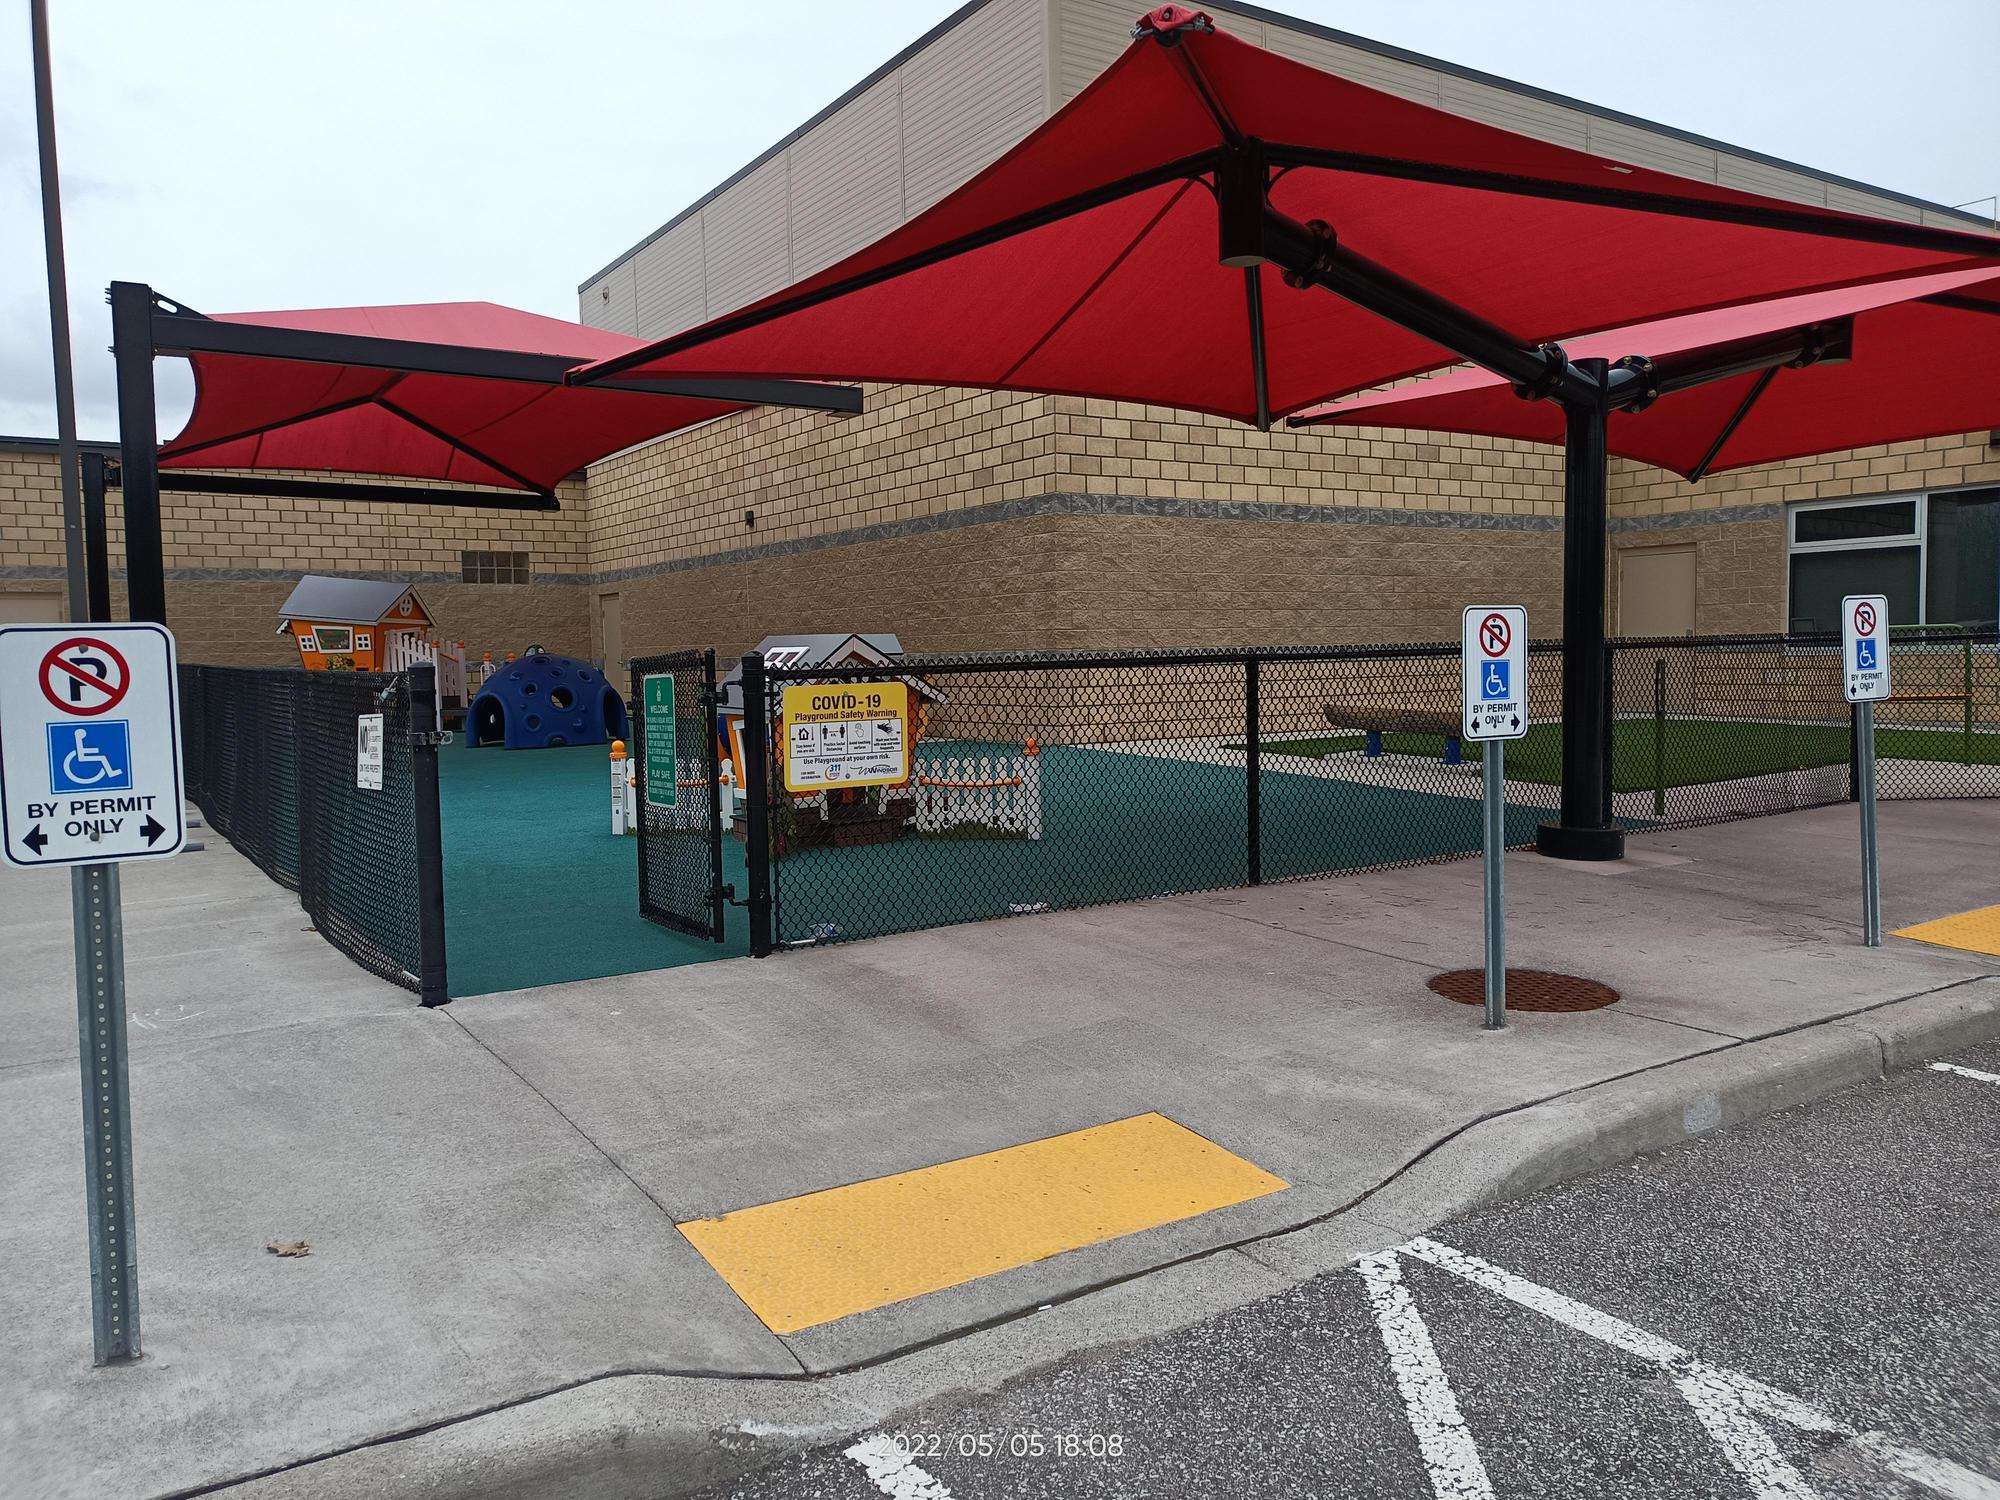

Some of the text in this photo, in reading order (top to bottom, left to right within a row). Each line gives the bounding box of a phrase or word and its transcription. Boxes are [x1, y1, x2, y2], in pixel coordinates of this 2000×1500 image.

[1861, 672, 1883, 681] PERMIT
[1860, 682, 1874, 690] ONLY
[812, 694, 881, 711] COVID-19
[1473, 702, 1518, 713] BY PERMIT
[650, 705, 669, 713] WELCOME
[795, 709, 897, 721] Playground Safety Warning
[1485, 715, 1506, 725] ONLY
[359, 725, 368, 753] NO
[814, 756, 845, 765] Playground
[829, 764, 841, 772] 311
[652, 769, 670, 779] PLAY SAFE
[27, 795, 156, 819] BY PERMIT
[64, 818, 124, 837] ONLY
